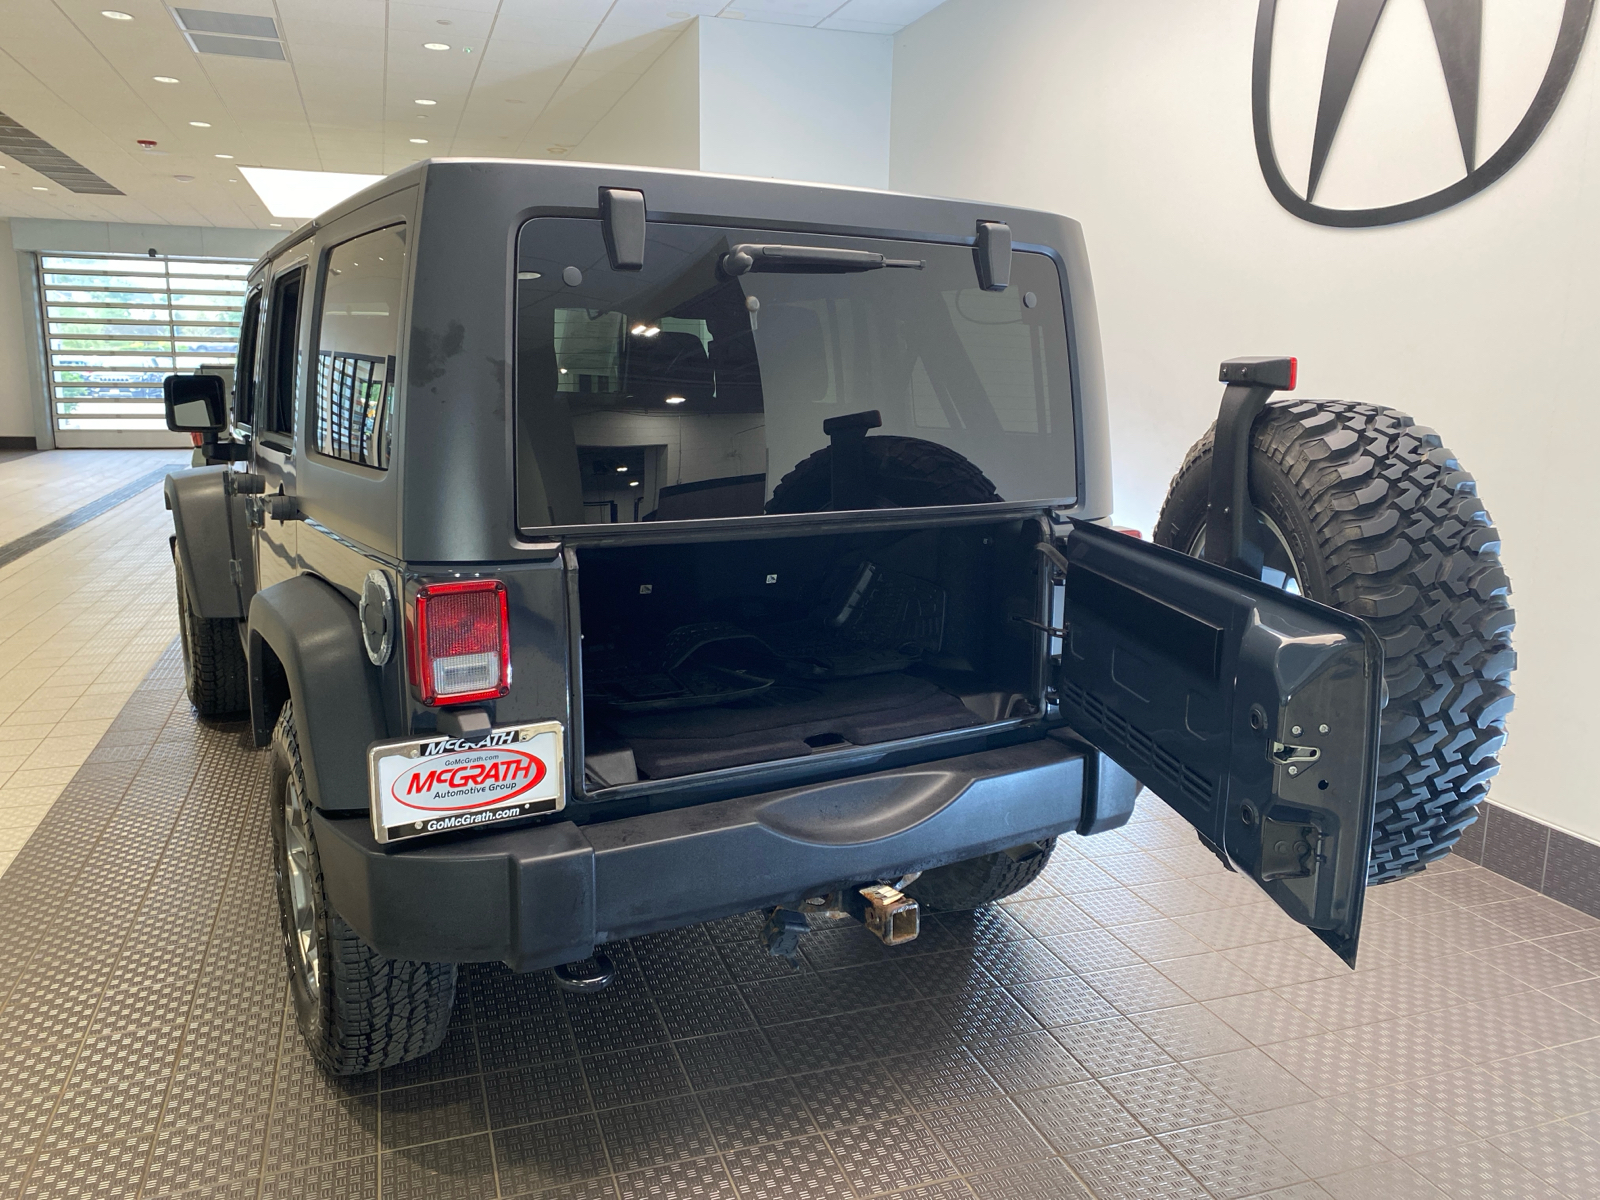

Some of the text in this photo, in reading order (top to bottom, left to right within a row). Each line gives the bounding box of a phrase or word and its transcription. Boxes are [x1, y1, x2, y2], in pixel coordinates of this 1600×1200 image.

[444, 754, 499, 767] GoMcGrath.com
[433, 782, 517, 800] Automotive Group
[427, 807, 520, 831] GoMcGrath.com
